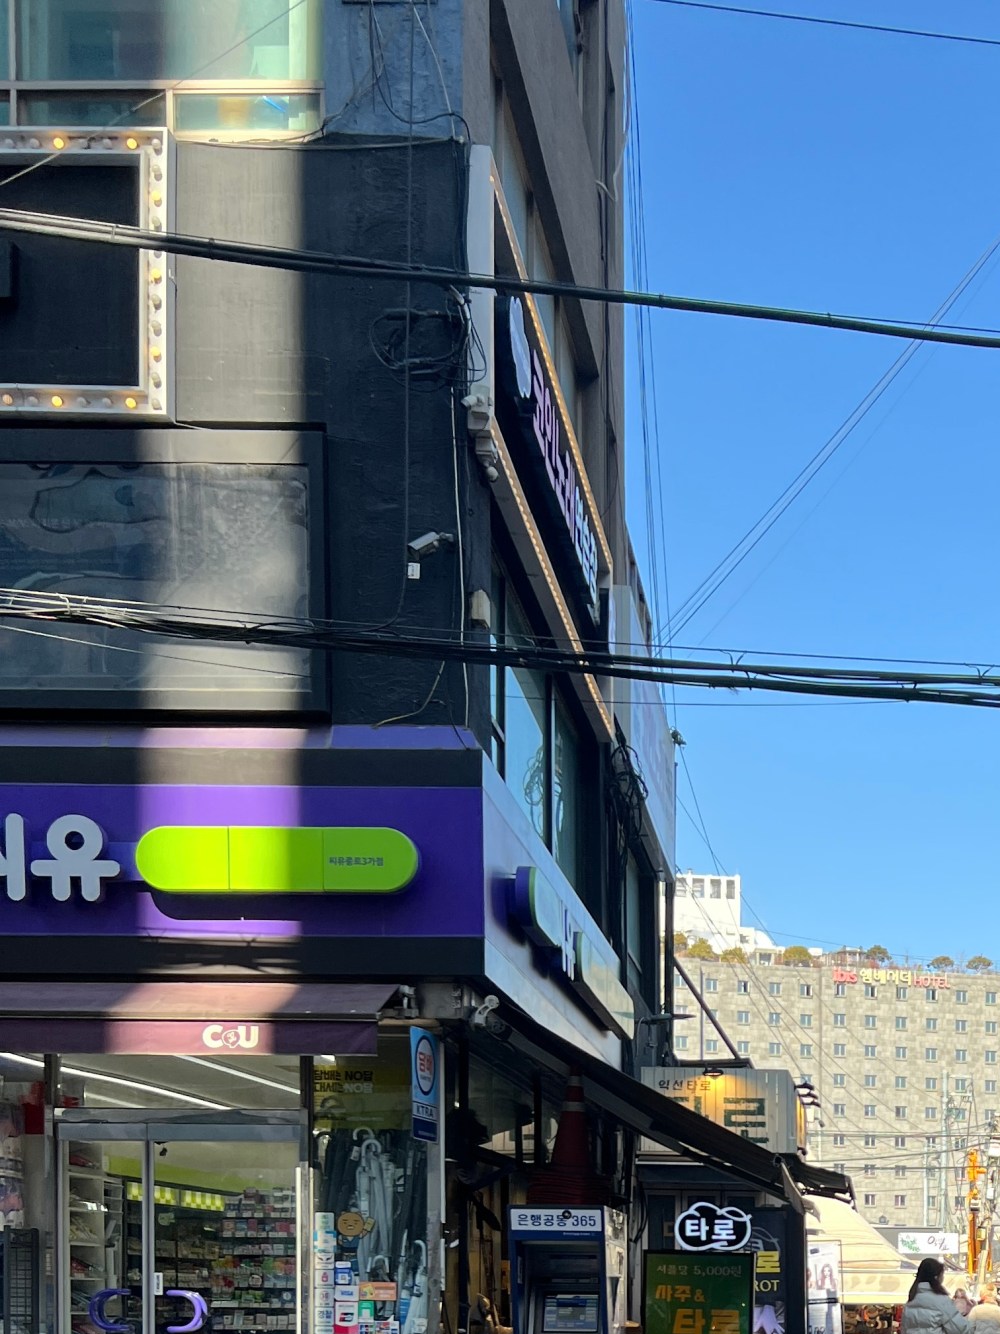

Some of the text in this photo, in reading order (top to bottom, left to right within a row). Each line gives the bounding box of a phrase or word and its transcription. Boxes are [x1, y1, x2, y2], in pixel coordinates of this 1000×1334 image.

[913, 970, 951, 988] HOTEL
[659, 1079, 711, 1094] 익선타로
[517, 1213, 596, 1227] 은행공동 365
[684, 1217, 737, 1241] 타로
[756, 1250, 781, 1273] 로
[693, 1265, 742, 1277] 5,000원
[754, 1279, 780, 1292] ROT
[655, 1285, 692, 1303] 사주
